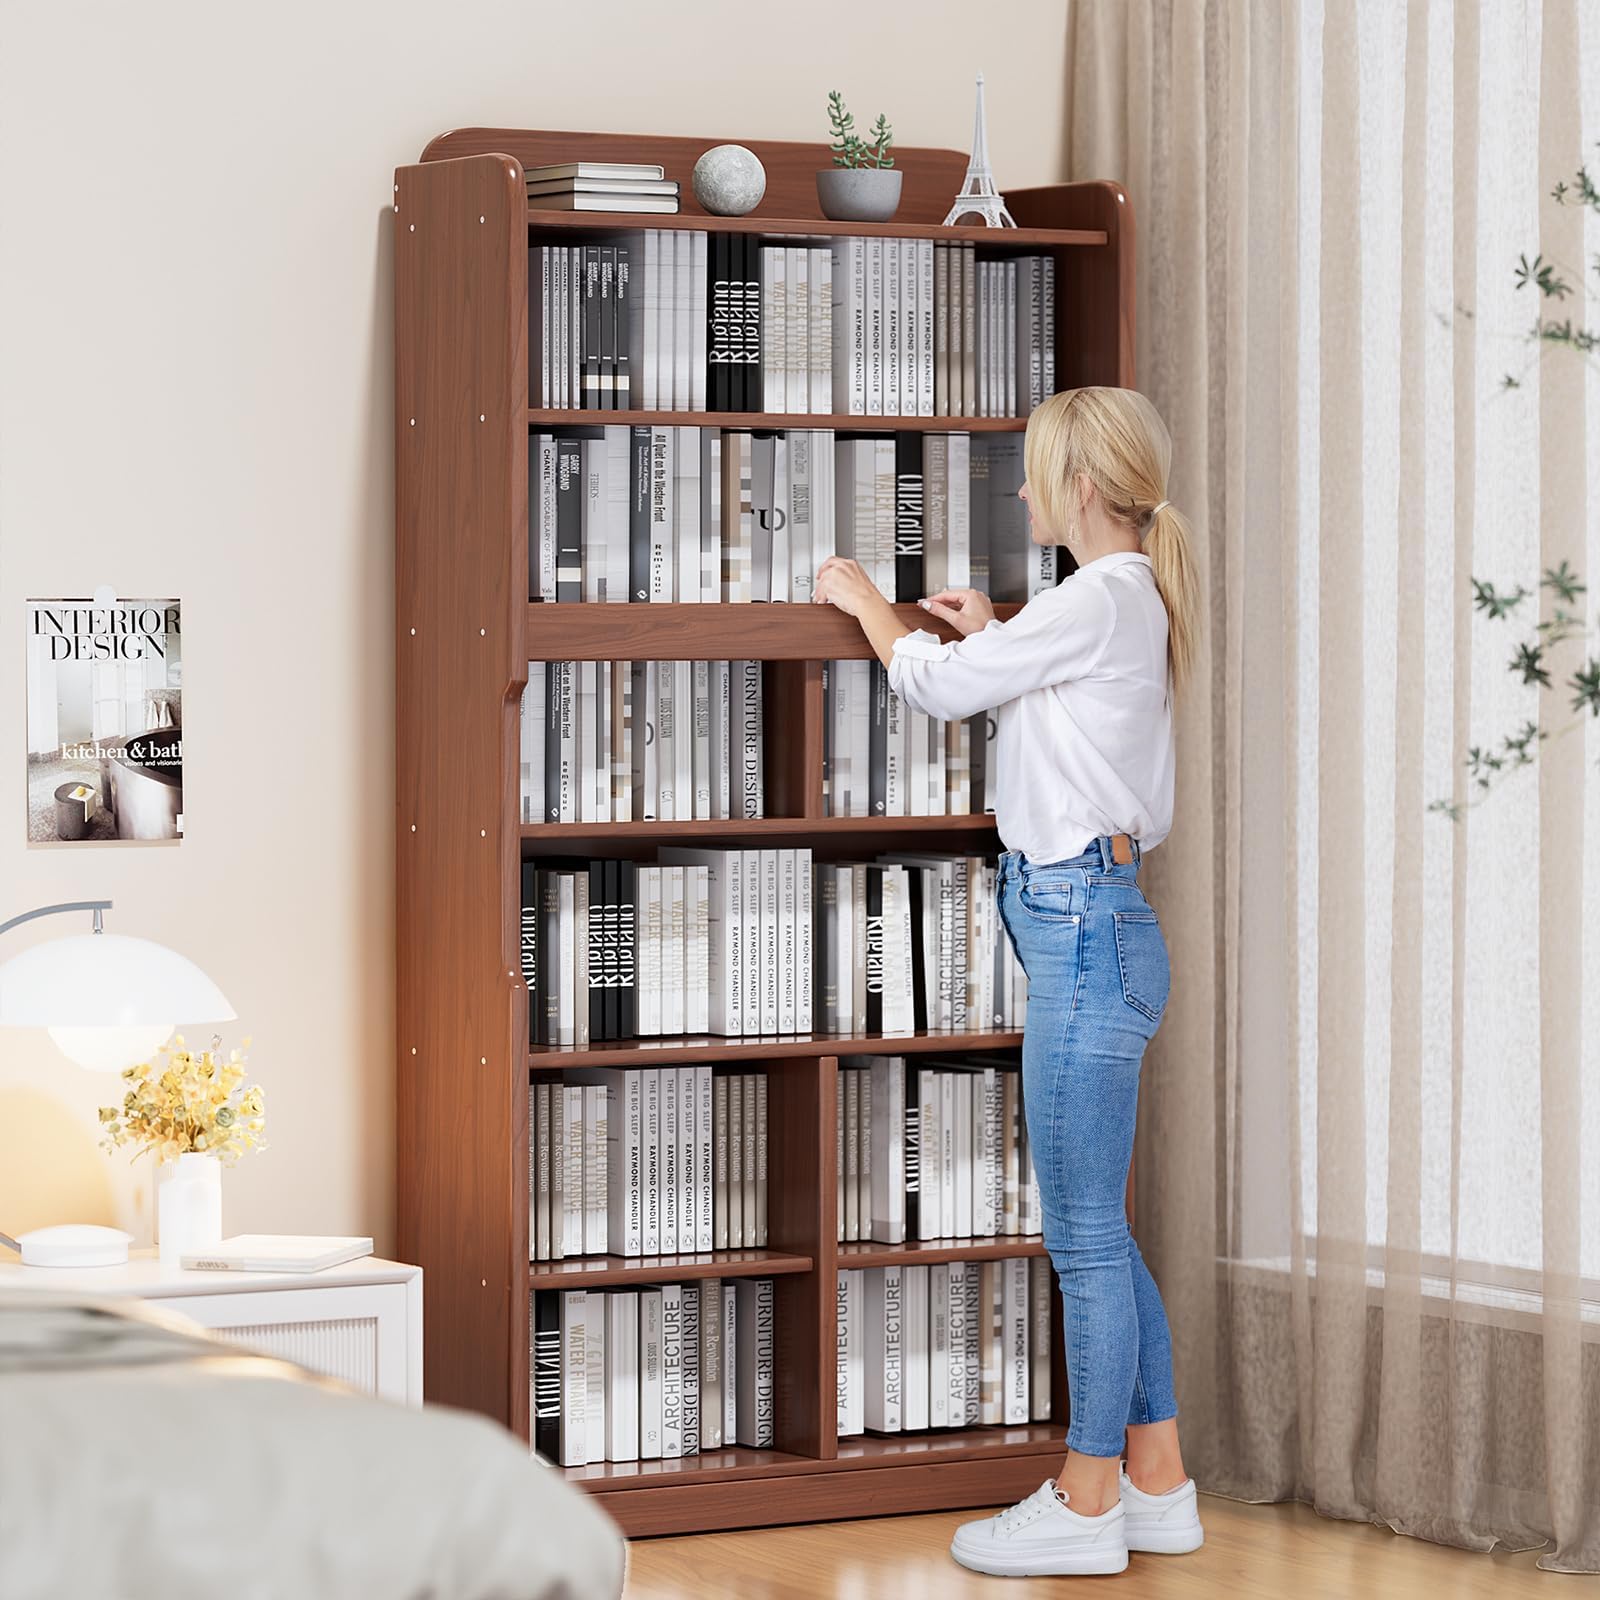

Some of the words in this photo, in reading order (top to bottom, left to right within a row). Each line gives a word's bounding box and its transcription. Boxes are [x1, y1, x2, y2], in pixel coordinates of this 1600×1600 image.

[560, 454, 569, 491] WINOGRAND
[570, 455, 579, 475] GARRY
[653, 444, 666, 459] Quiet
[654, 469, 666, 478] the
[654, 480, 666, 506] Western
[654, 507, 666, 522] Front
[931, 494, 946, 540] Revolution
[544, 544, 550, 552] OF
[32, 609, 181, 634] INTERIOR
[50, 635, 165, 660] DESIGN
[562, 677, 569, 685] on
[562, 686, 571, 696] the
[562, 697, 571, 723] Western
[562, 723, 571, 738] Front
[62, 742, 128, 760] kitchen
[130, 742, 146, 758] &
[955, 862, 968, 958] FURNITURE
[940, 879, 953, 1002] ARCHITECTURE
[955, 964, 968, 1024] DESIGN
[555, 1145, 563, 1192] Revolution
[758, 1283, 772, 1380] FURNITURE
[966, 1264, 978, 1360] FURNITURE
[570, 1324, 585, 1366] WATER
[684, 1290, 698, 1389] FURNITURE
[706, 1336, 719, 1382] Revolution
[887, 1278, 900, 1405] ARCHITECTURE
[951, 1274, 964, 1400] ARCHITECTURE
[664, 1301, 680, 1430] ARCHITECTURE
[570, 1371, 585, 1425] FINANCE
[728, 1392, 734, 1400] OF
[758, 1386, 772, 1447] DESIGN
[966, 1365, 978, 1424] DESIGN
[684, 1395, 698, 1456] DESIGN
